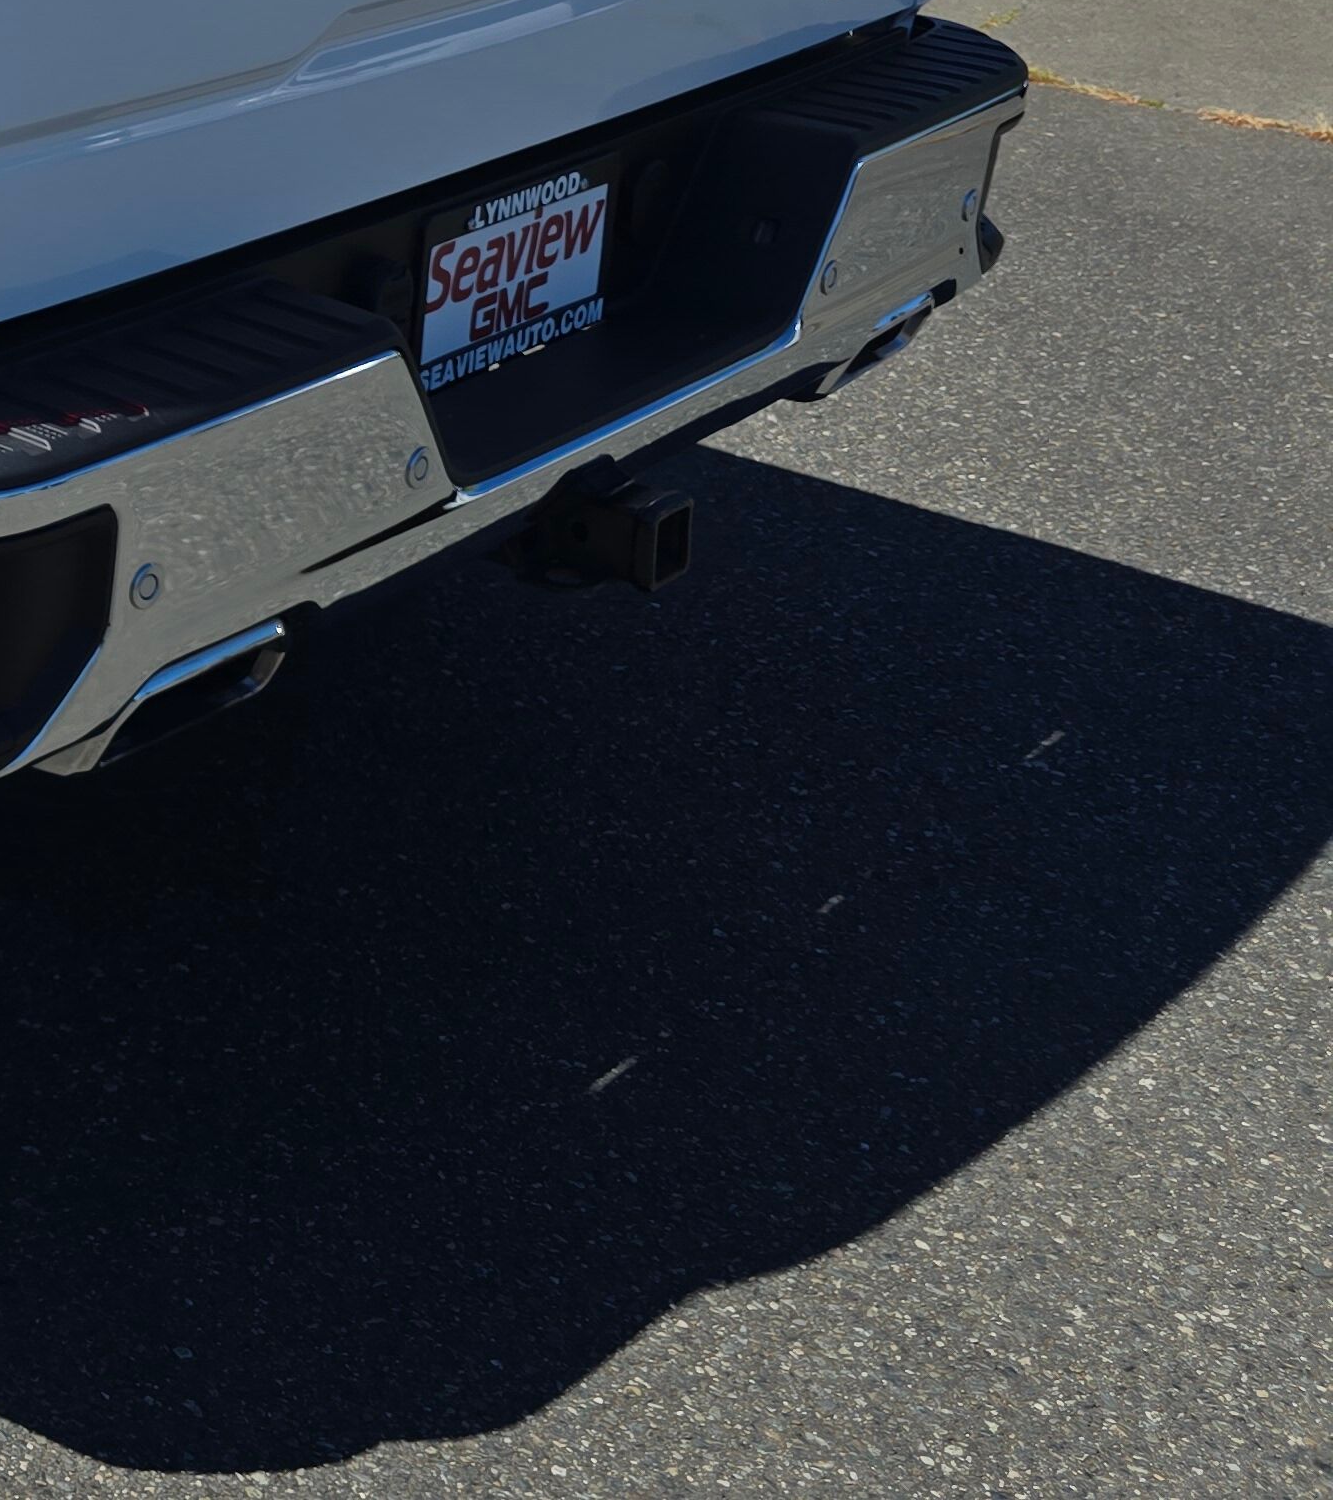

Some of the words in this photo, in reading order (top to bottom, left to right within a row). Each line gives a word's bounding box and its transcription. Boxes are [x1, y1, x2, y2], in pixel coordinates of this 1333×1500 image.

[474, 171, 581, 229] LYNNWOOD
[424, 199, 605, 314] Seaview
[420, 298, 604, 392] SEAVIEWAUTO.COM
[469, 271, 549, 342] GMC
